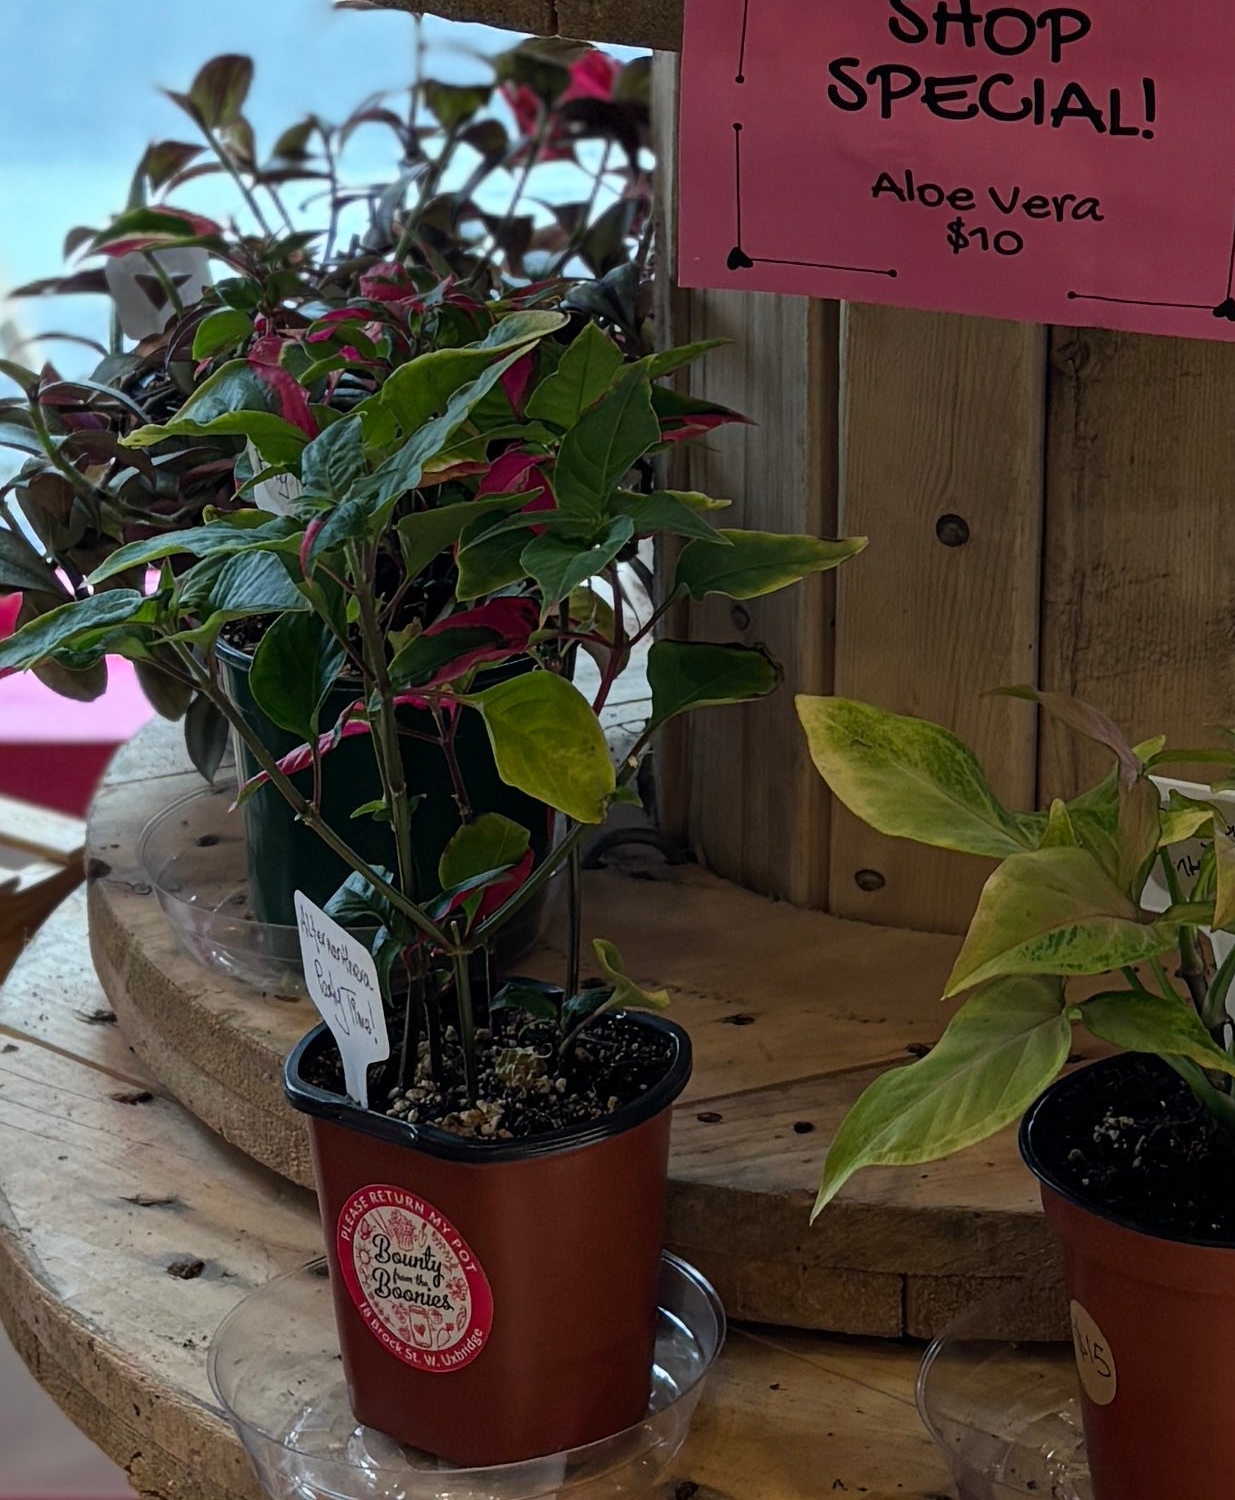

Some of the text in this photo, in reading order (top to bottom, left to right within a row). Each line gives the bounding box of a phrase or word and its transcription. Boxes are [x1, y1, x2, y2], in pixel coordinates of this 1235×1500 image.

[827, 57, 1157, 139] SPECIAL!
[871, 169, 1105, 223] Aloe Vera
[946, 217, 1025, 257] $10
[341, 1190, 477, 1272] PLEASE RETURN MY POT
[372, 1233, 445, 1288] Bounty
[393, 1268, 430, 1288] from the
[372, 1267, 455, 1312] Boonies
[370, 1318, 403, 1354] Brock
[424, 1355, 440, 1367] W.
[442, 1328, 483, 1366] Uxbridge
